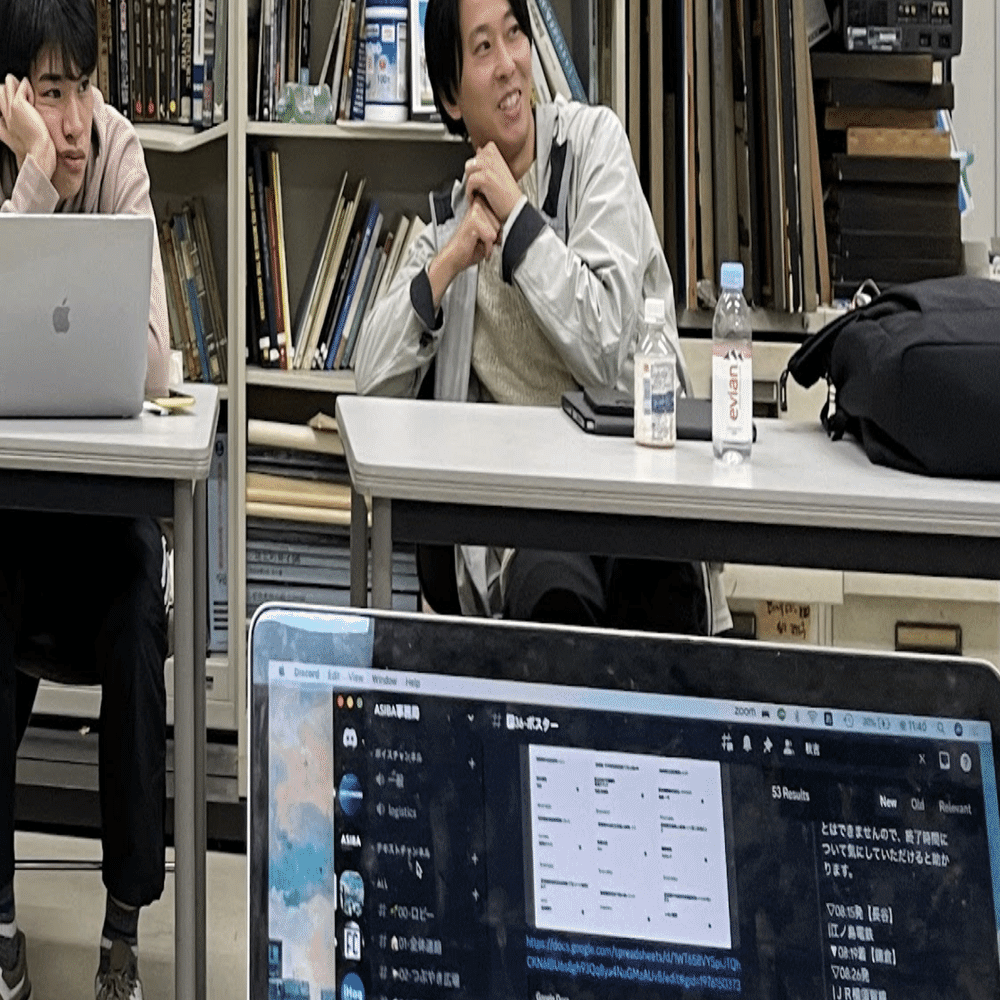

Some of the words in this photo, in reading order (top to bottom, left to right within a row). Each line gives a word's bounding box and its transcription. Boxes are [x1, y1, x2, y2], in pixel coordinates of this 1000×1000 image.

[728, 364, 739, 421] evian
[348, 671, 364, 683] View
[372, 673, 398, 686] Window
[405, 677, 421, 689] Help
[735, 706, 756, 717] zoom
[772, 785, 782, 798] 53
[783, 786, 810, 802] Results
[880, 795, 897, 809] New
[911, 797, 925, 811] Old
[939, 800, 972, 815] Relevant
[824, 862, 853, 879] ります。
